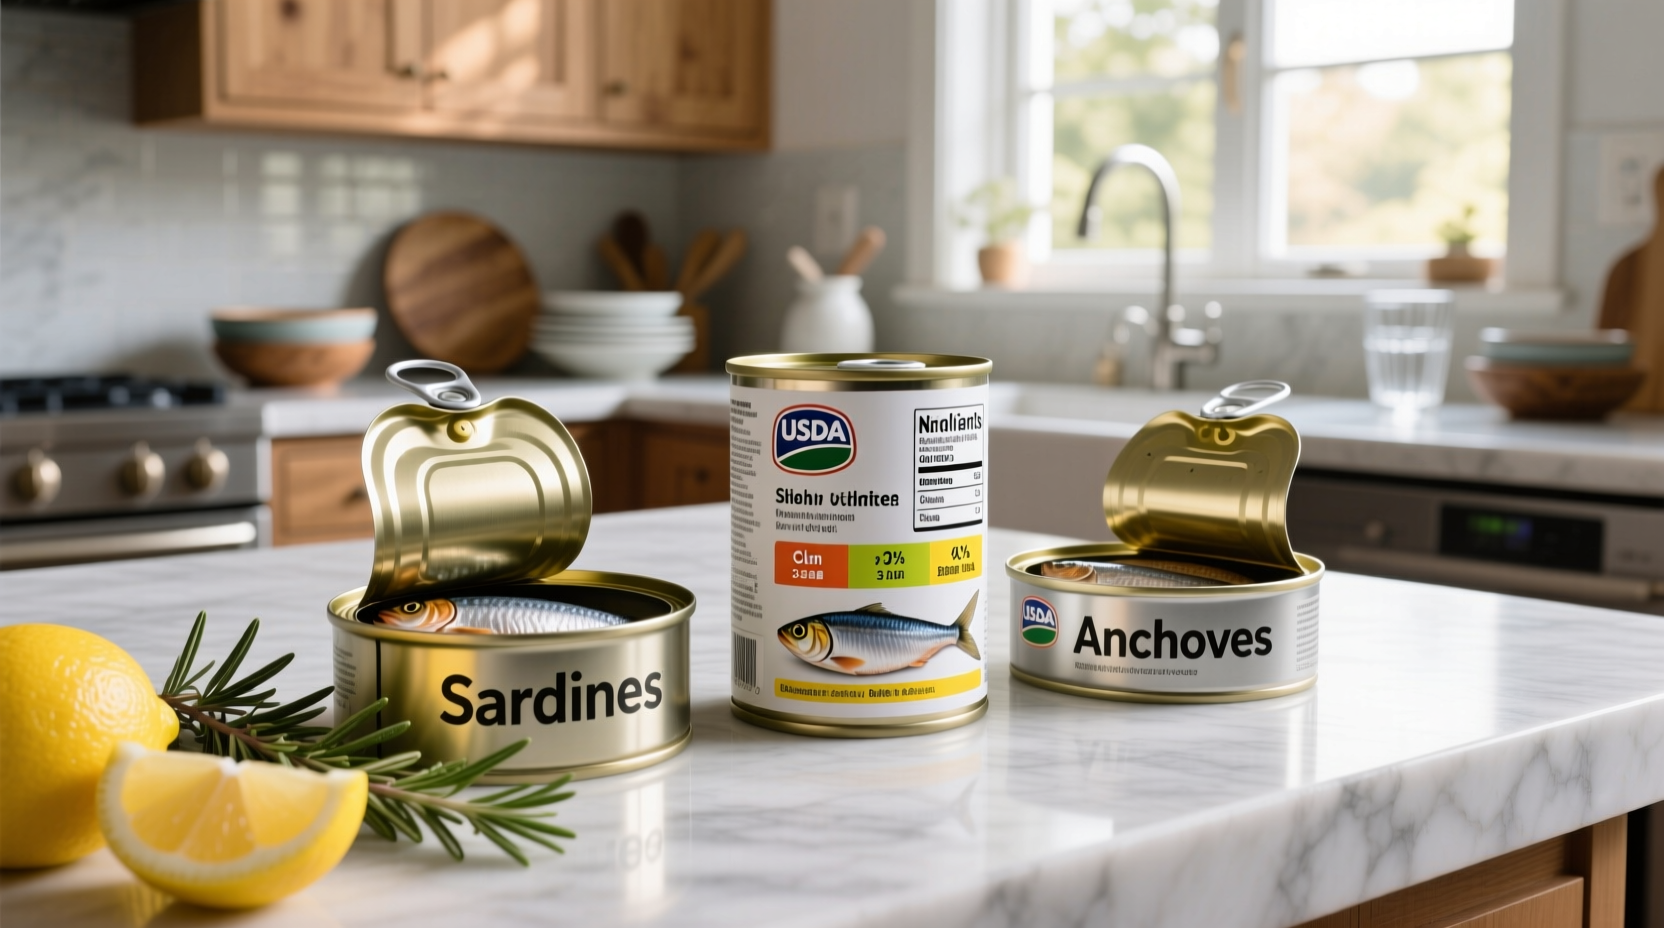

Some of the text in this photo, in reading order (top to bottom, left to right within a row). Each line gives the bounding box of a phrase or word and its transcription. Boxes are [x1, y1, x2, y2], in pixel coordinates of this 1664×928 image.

[781, 418, 847, 442] USDA
[1073, 615, 1272, 660] Anchoves
[440, 670, 663, 727] Sardines
